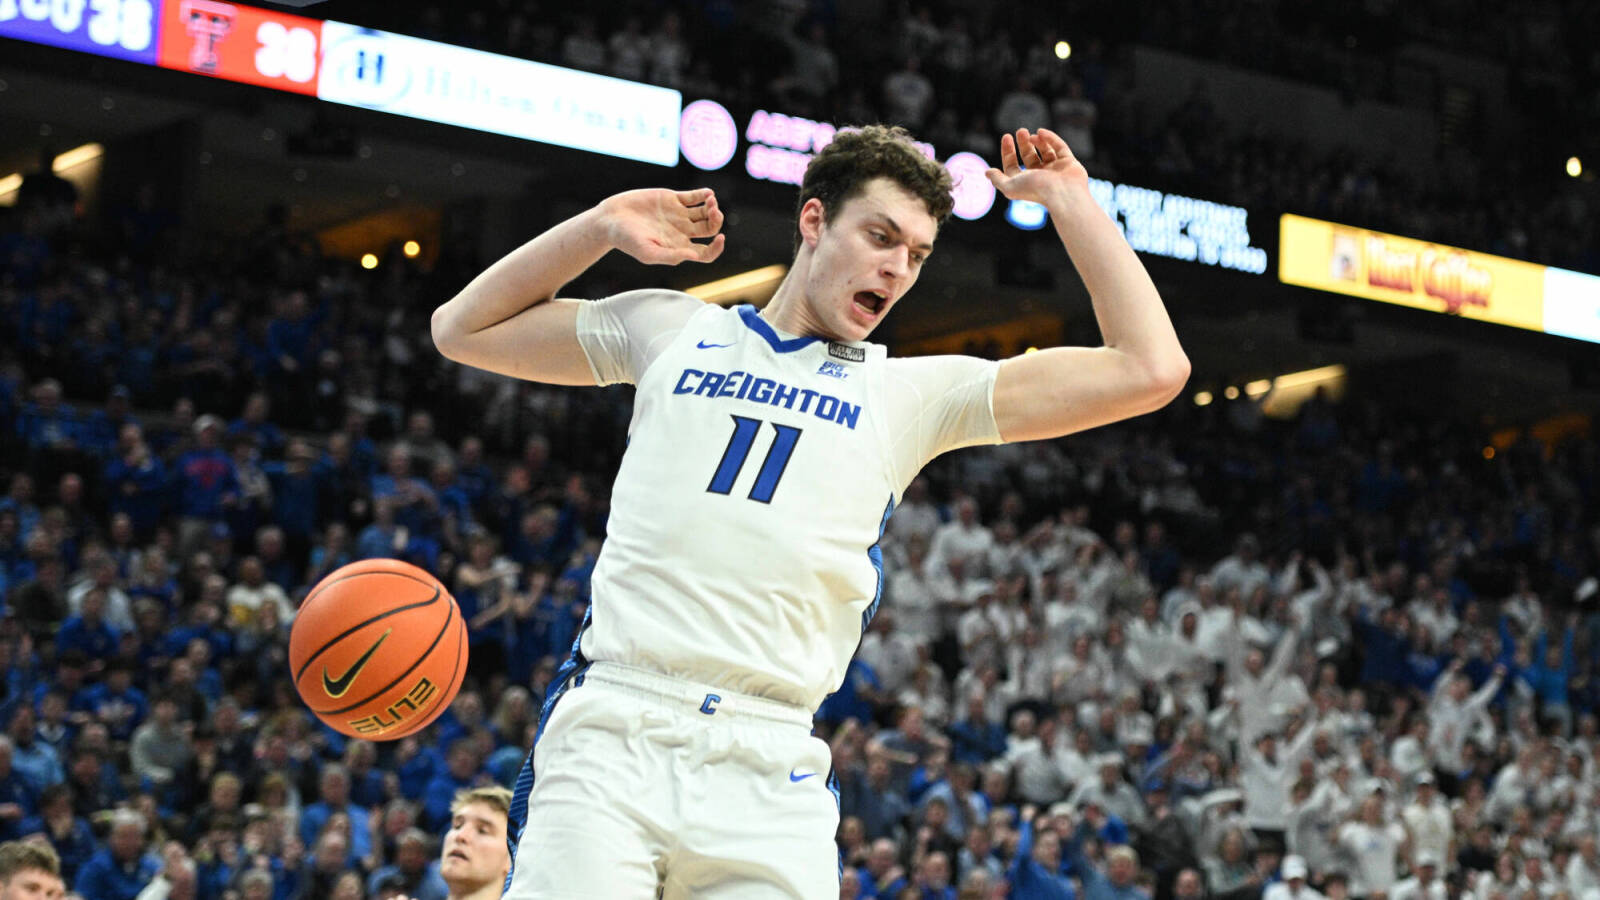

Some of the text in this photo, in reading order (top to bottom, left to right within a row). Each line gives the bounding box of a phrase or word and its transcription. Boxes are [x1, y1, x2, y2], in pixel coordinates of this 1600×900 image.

[672, 368, 862, 430] CREIGHTON
[705, 413, 803, 505] 11
[348, 676, 440, 736] ELITE
[699, 693, 722, 715] C
